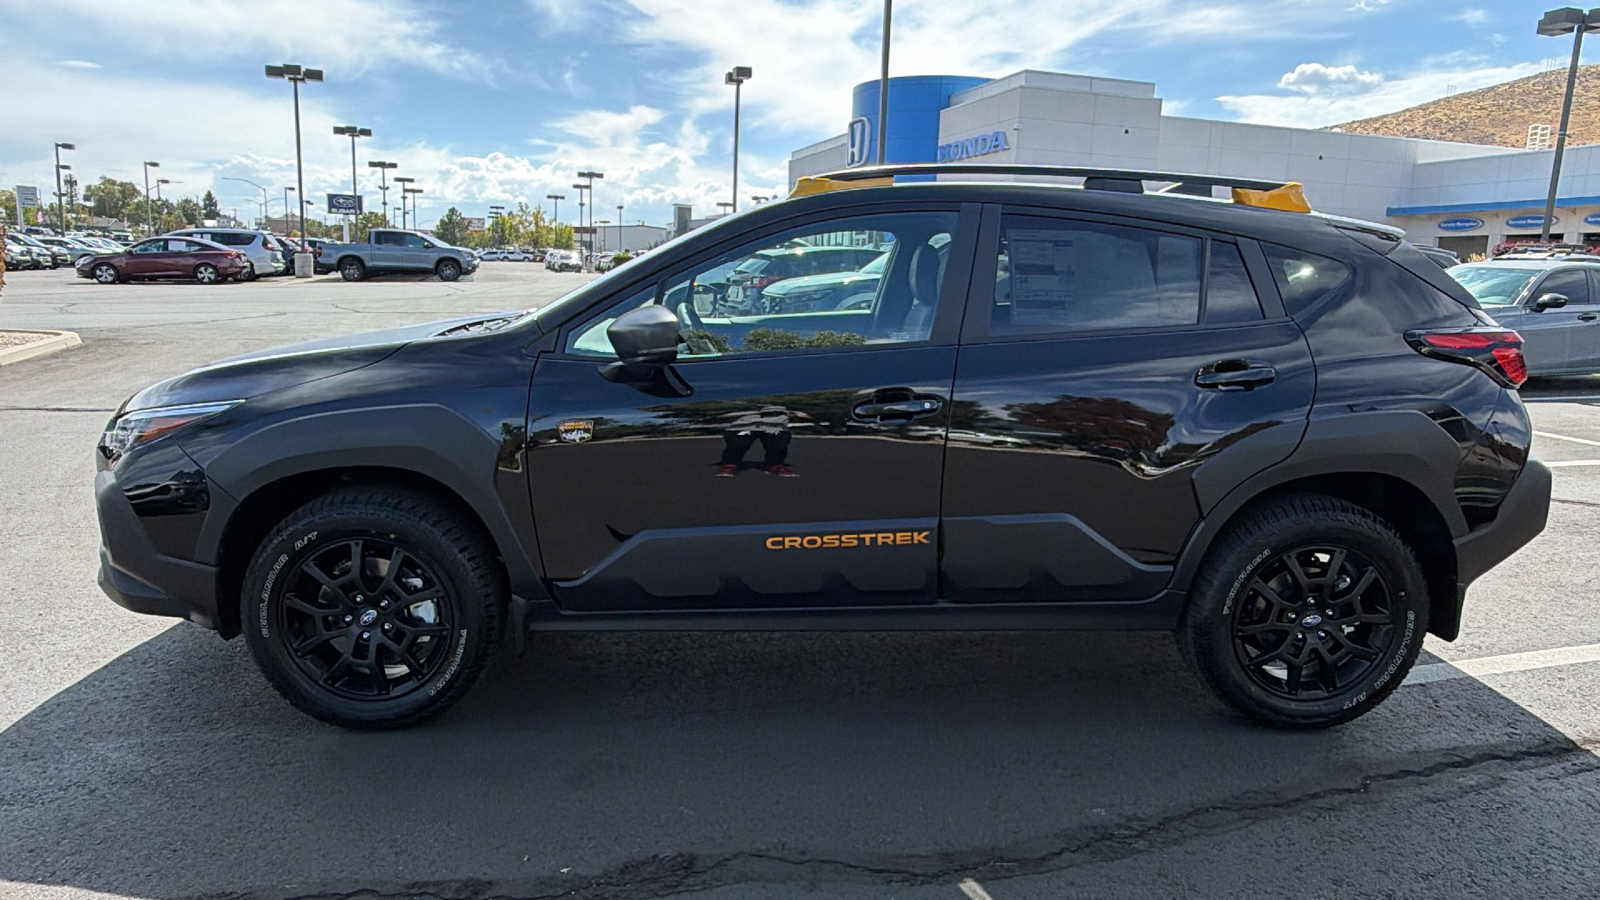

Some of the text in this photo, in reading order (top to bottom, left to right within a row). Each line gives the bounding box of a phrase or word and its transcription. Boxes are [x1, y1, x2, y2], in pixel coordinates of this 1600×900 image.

[938, 131, 1010, 162] HONDA
[766, 531, 930, 550] CROSSTREK
[261, 531, 318, 638] GEOLANDAR A/T
[1223, 549, 1271, 615] YOKOHAMA
[1343, 611, 1415, 710] GEOLANDAR A/T
